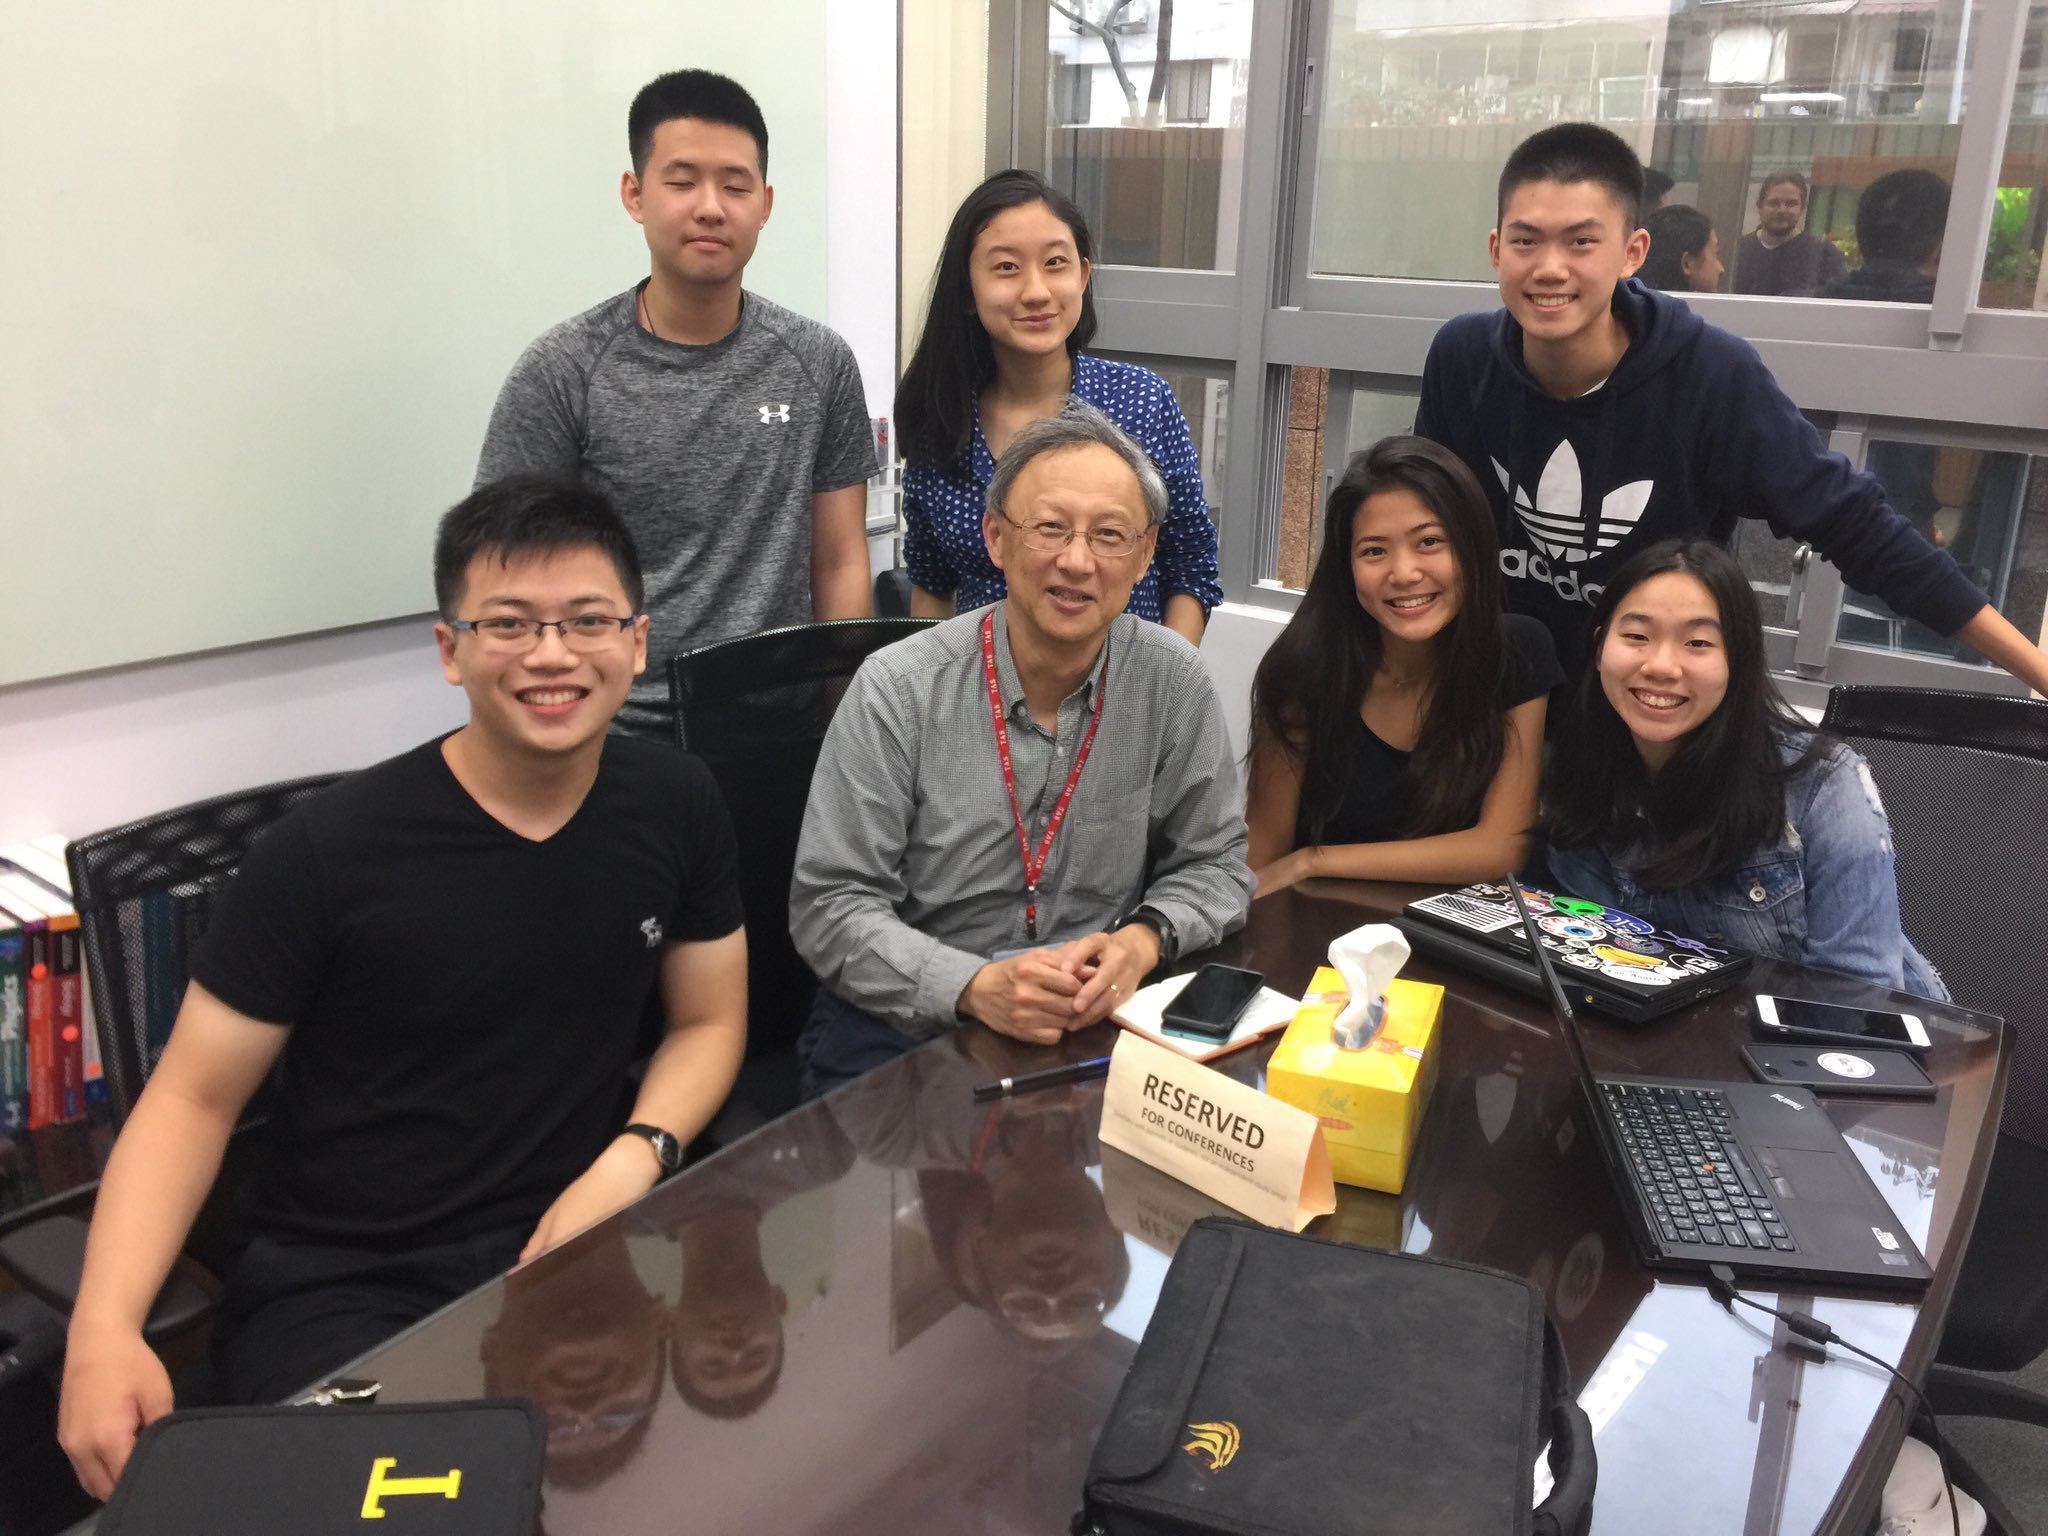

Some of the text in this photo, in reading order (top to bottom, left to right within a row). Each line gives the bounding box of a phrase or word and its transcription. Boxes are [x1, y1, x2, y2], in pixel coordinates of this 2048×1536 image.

[1140, 1107, 1164, 1130] FOR
[1167, 1122, 1256, 1173] CONFERENCES
[1142, 1072, 1265, 1150] RESERVED
[361, 1457, 462, 1519] T
